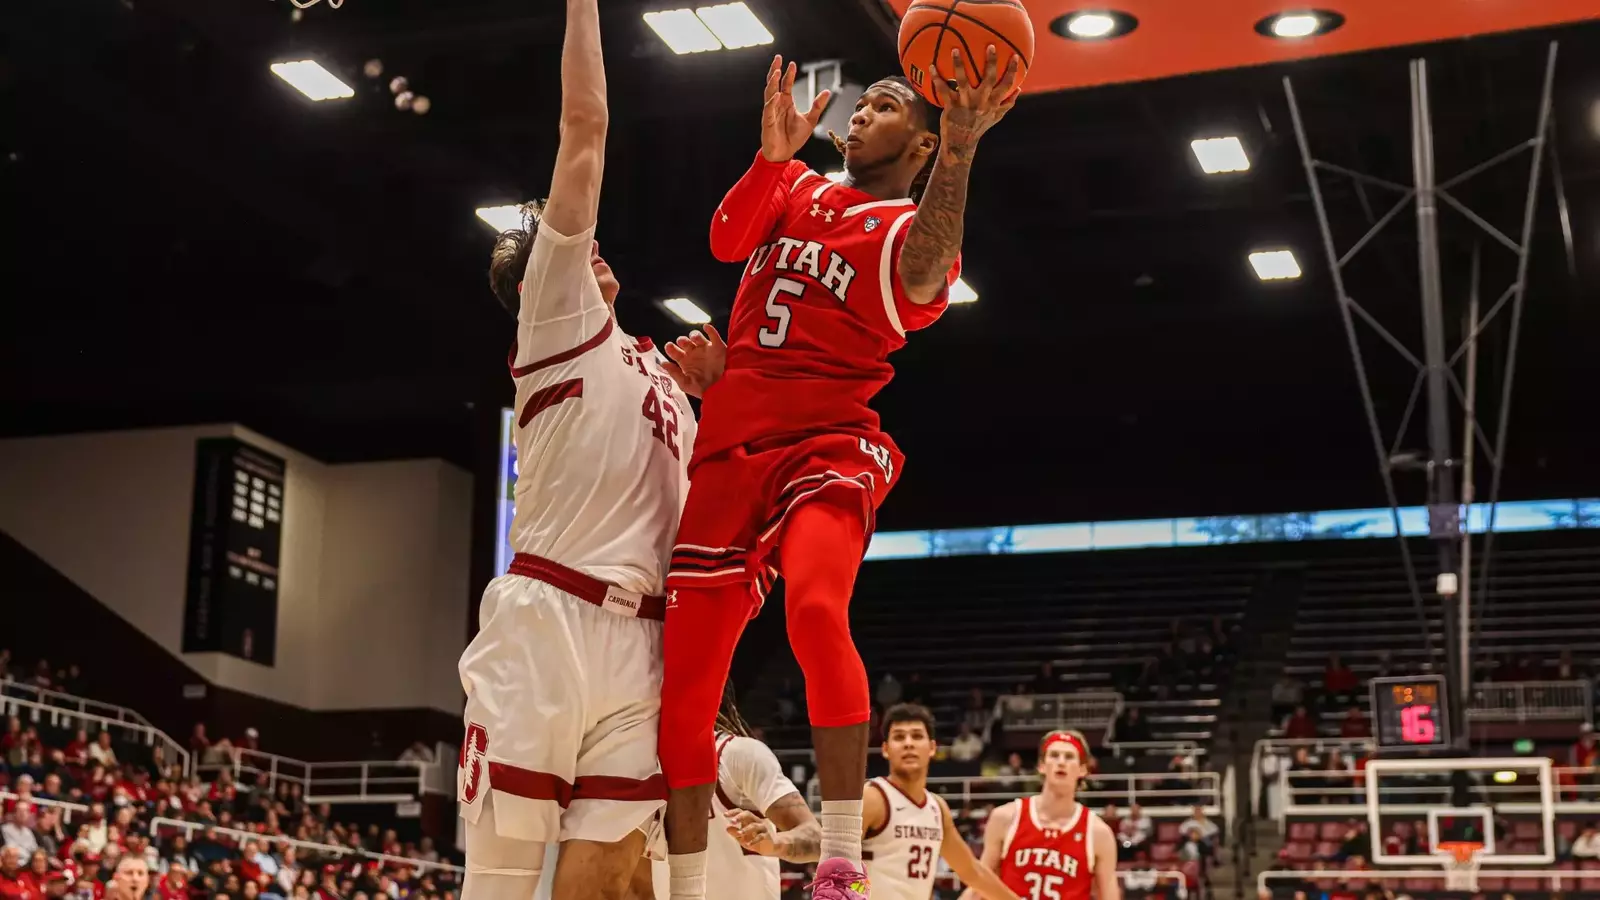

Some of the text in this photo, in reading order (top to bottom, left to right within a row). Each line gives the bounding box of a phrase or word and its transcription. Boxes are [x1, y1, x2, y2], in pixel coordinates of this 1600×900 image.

[750, 236, 856, 302] UTAH
[758, 277, 806, 347] 5
[642, 385, 680, 461] 42
[607, 595, 637, 609] CARDINAL
[907, 844, 933, 880] 23
[1015, 847, 1079, 878] UTAH
[1023, 871, 1064, 900] 35
